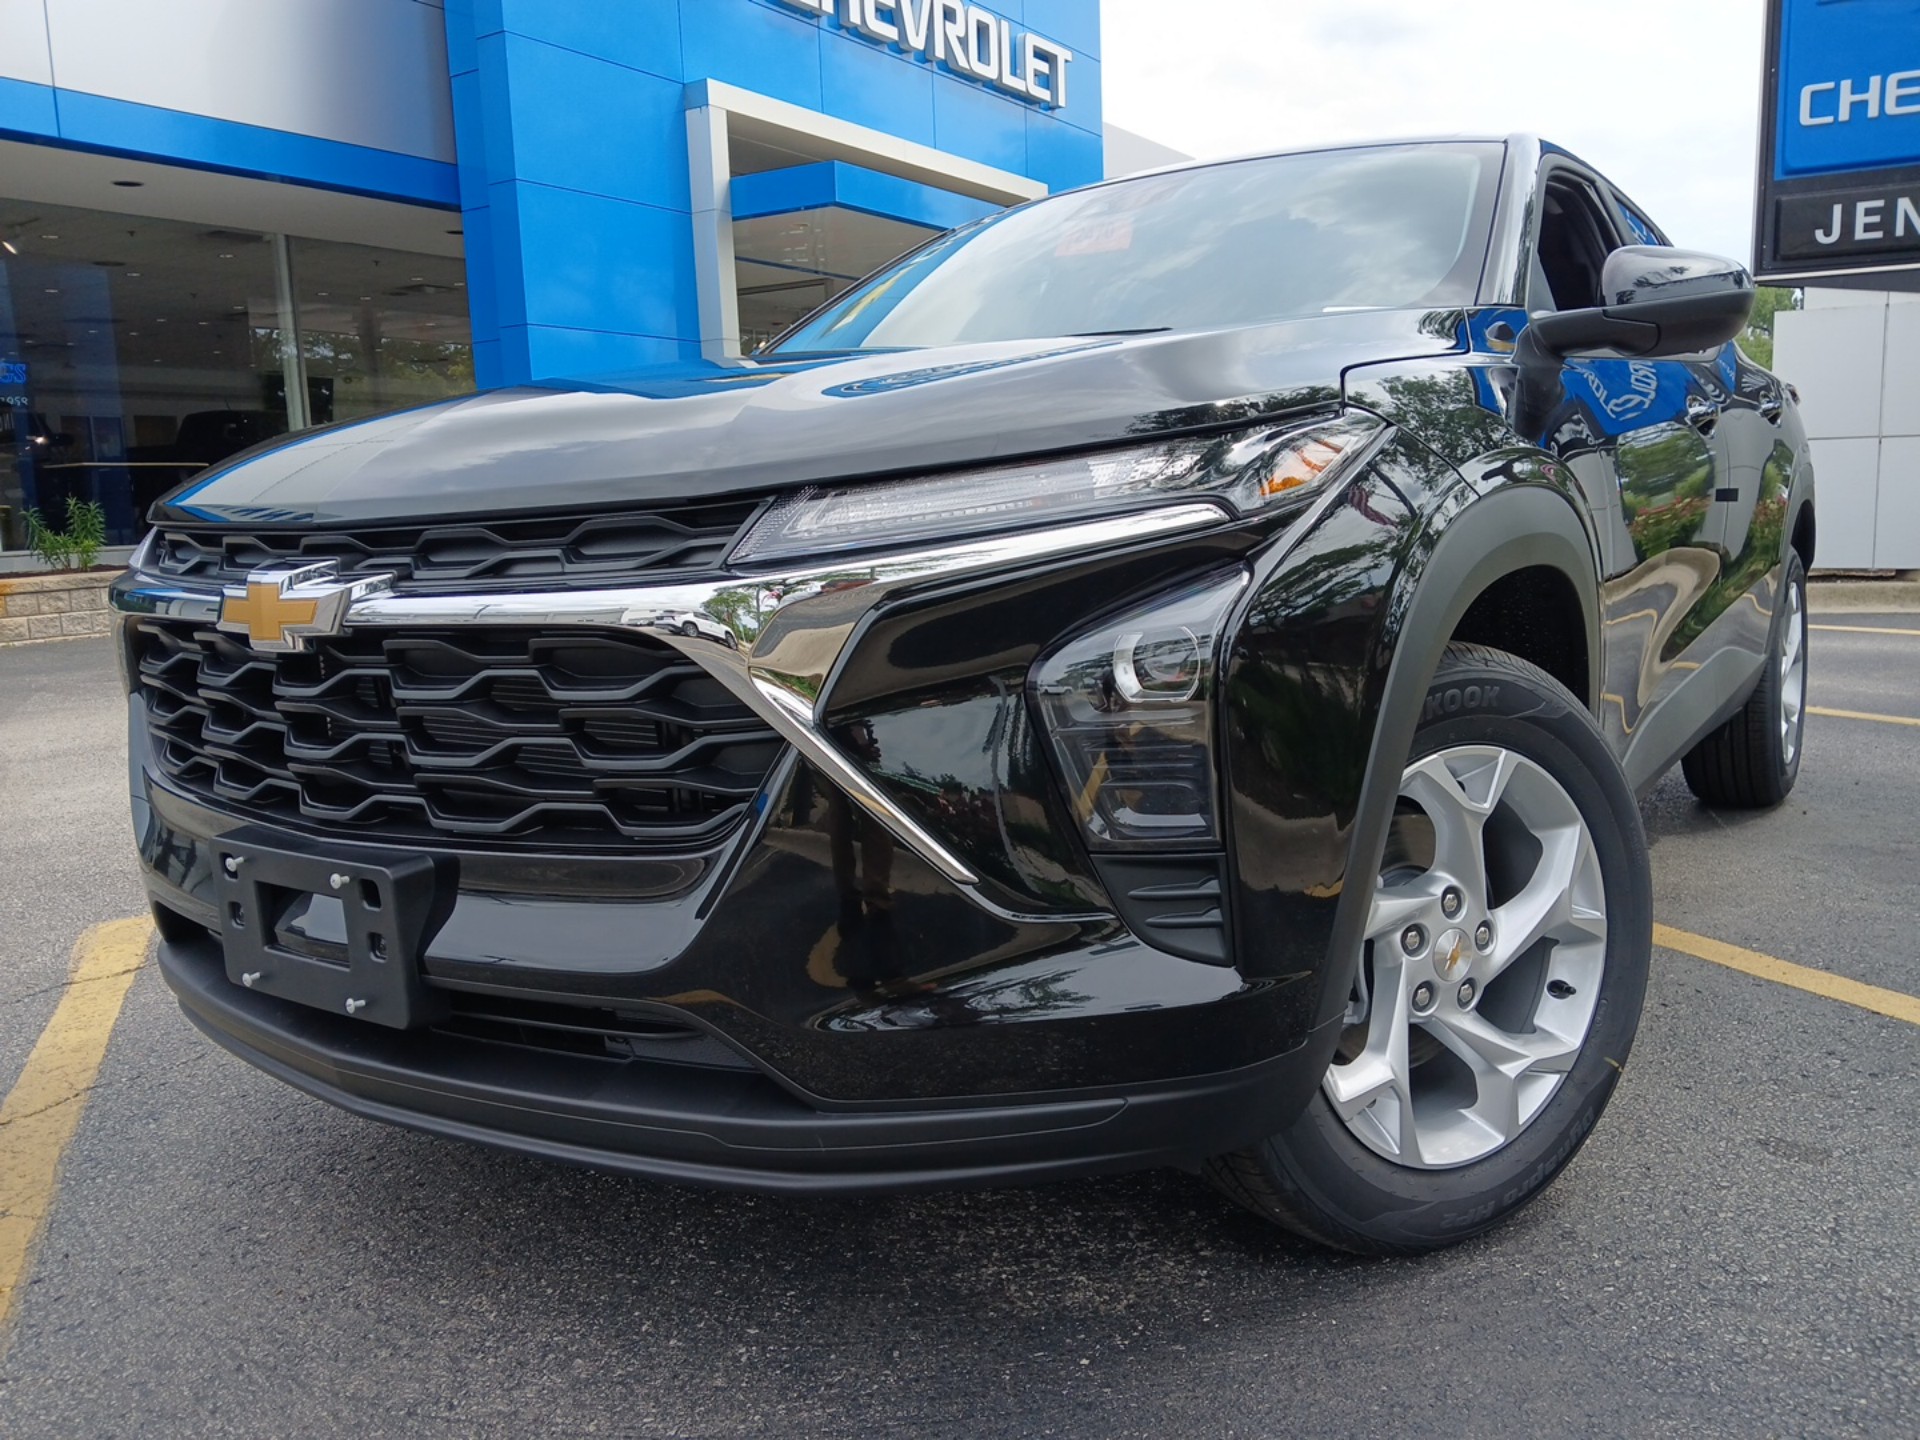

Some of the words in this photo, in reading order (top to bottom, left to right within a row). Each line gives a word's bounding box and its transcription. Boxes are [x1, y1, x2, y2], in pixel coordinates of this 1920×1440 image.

[783, 0, 1072, 109] EVROLET
[1799, 69, 1920, 126] CHE
[1815, 197, 1920, 245] JEN
